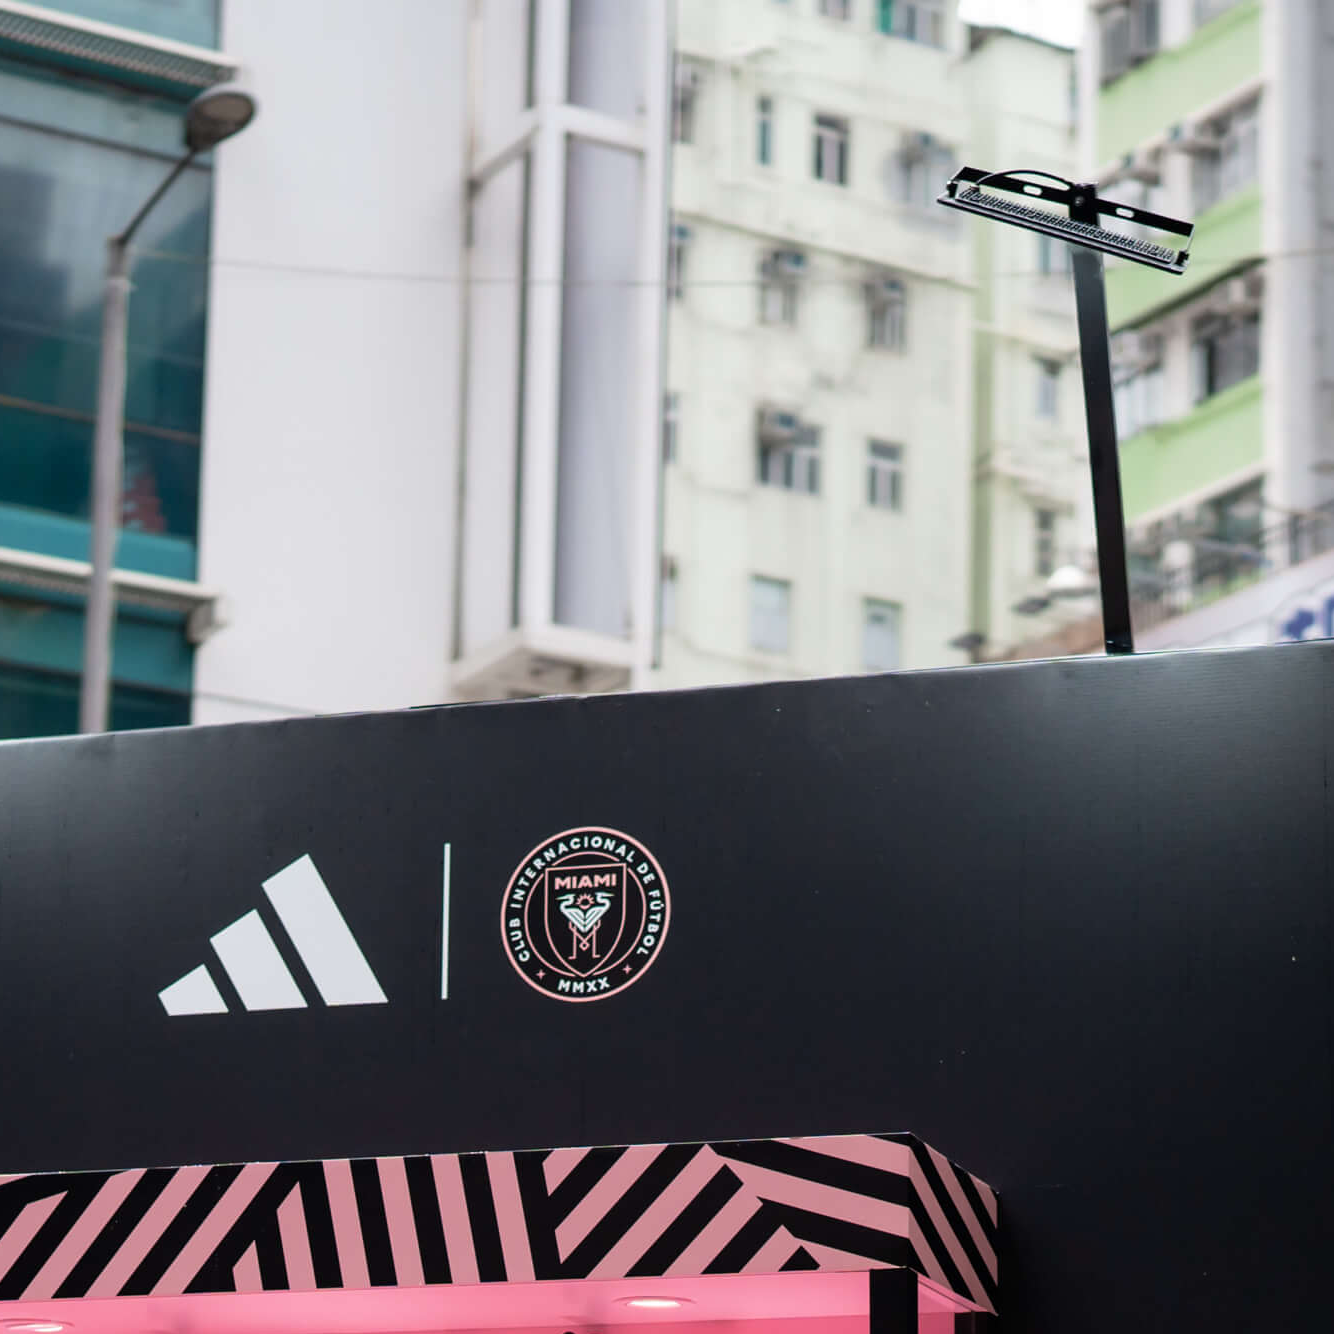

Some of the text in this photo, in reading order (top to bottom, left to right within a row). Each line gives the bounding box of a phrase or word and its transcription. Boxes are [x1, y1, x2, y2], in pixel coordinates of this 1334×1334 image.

[511, 836, 635, 909] INTERNACIONAL
[554, 873, 617, 890] MIAMI
[636, 863, 655, 884] DE
[509, 918, 530, 962] CLUB
[557, 976, 610, 993] MMXX
